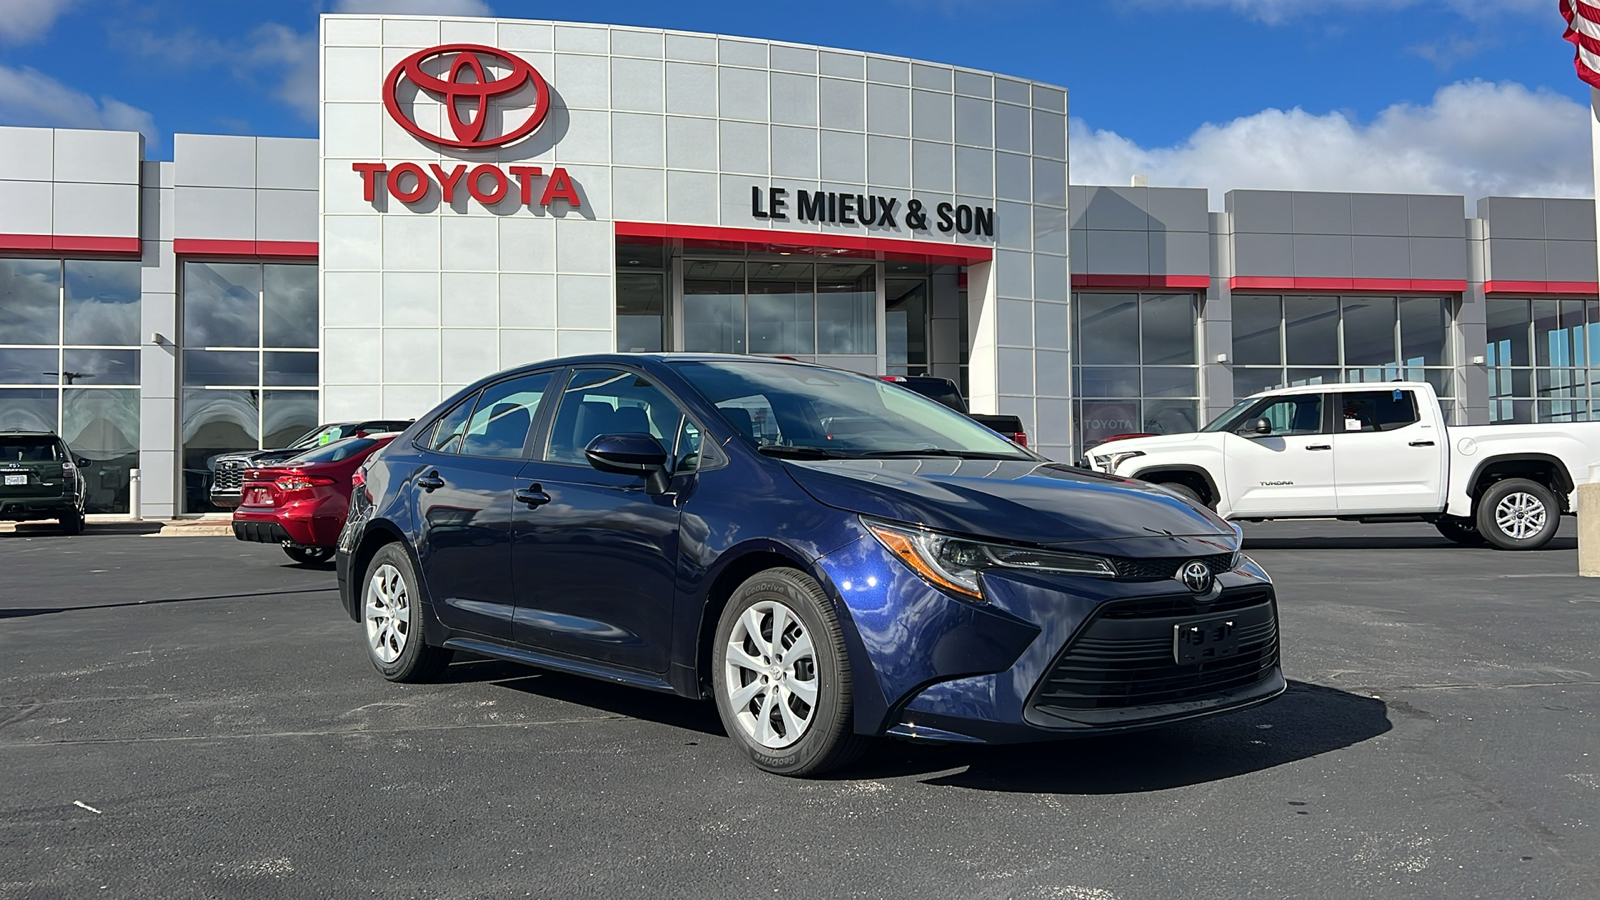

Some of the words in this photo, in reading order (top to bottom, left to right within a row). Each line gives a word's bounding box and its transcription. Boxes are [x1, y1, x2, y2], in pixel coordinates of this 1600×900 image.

[352, 162, 581, 207] TOYOTA
[752, 186, 786, 219] LE
[797, 189, 898, 228] MIEUX
[905, 198, 928, 231] &
[936, 202, 994, 237] SON
[1084, 419, 1133, 430] TOYOTA
[745, 582, 785, 597] GeoDrive
